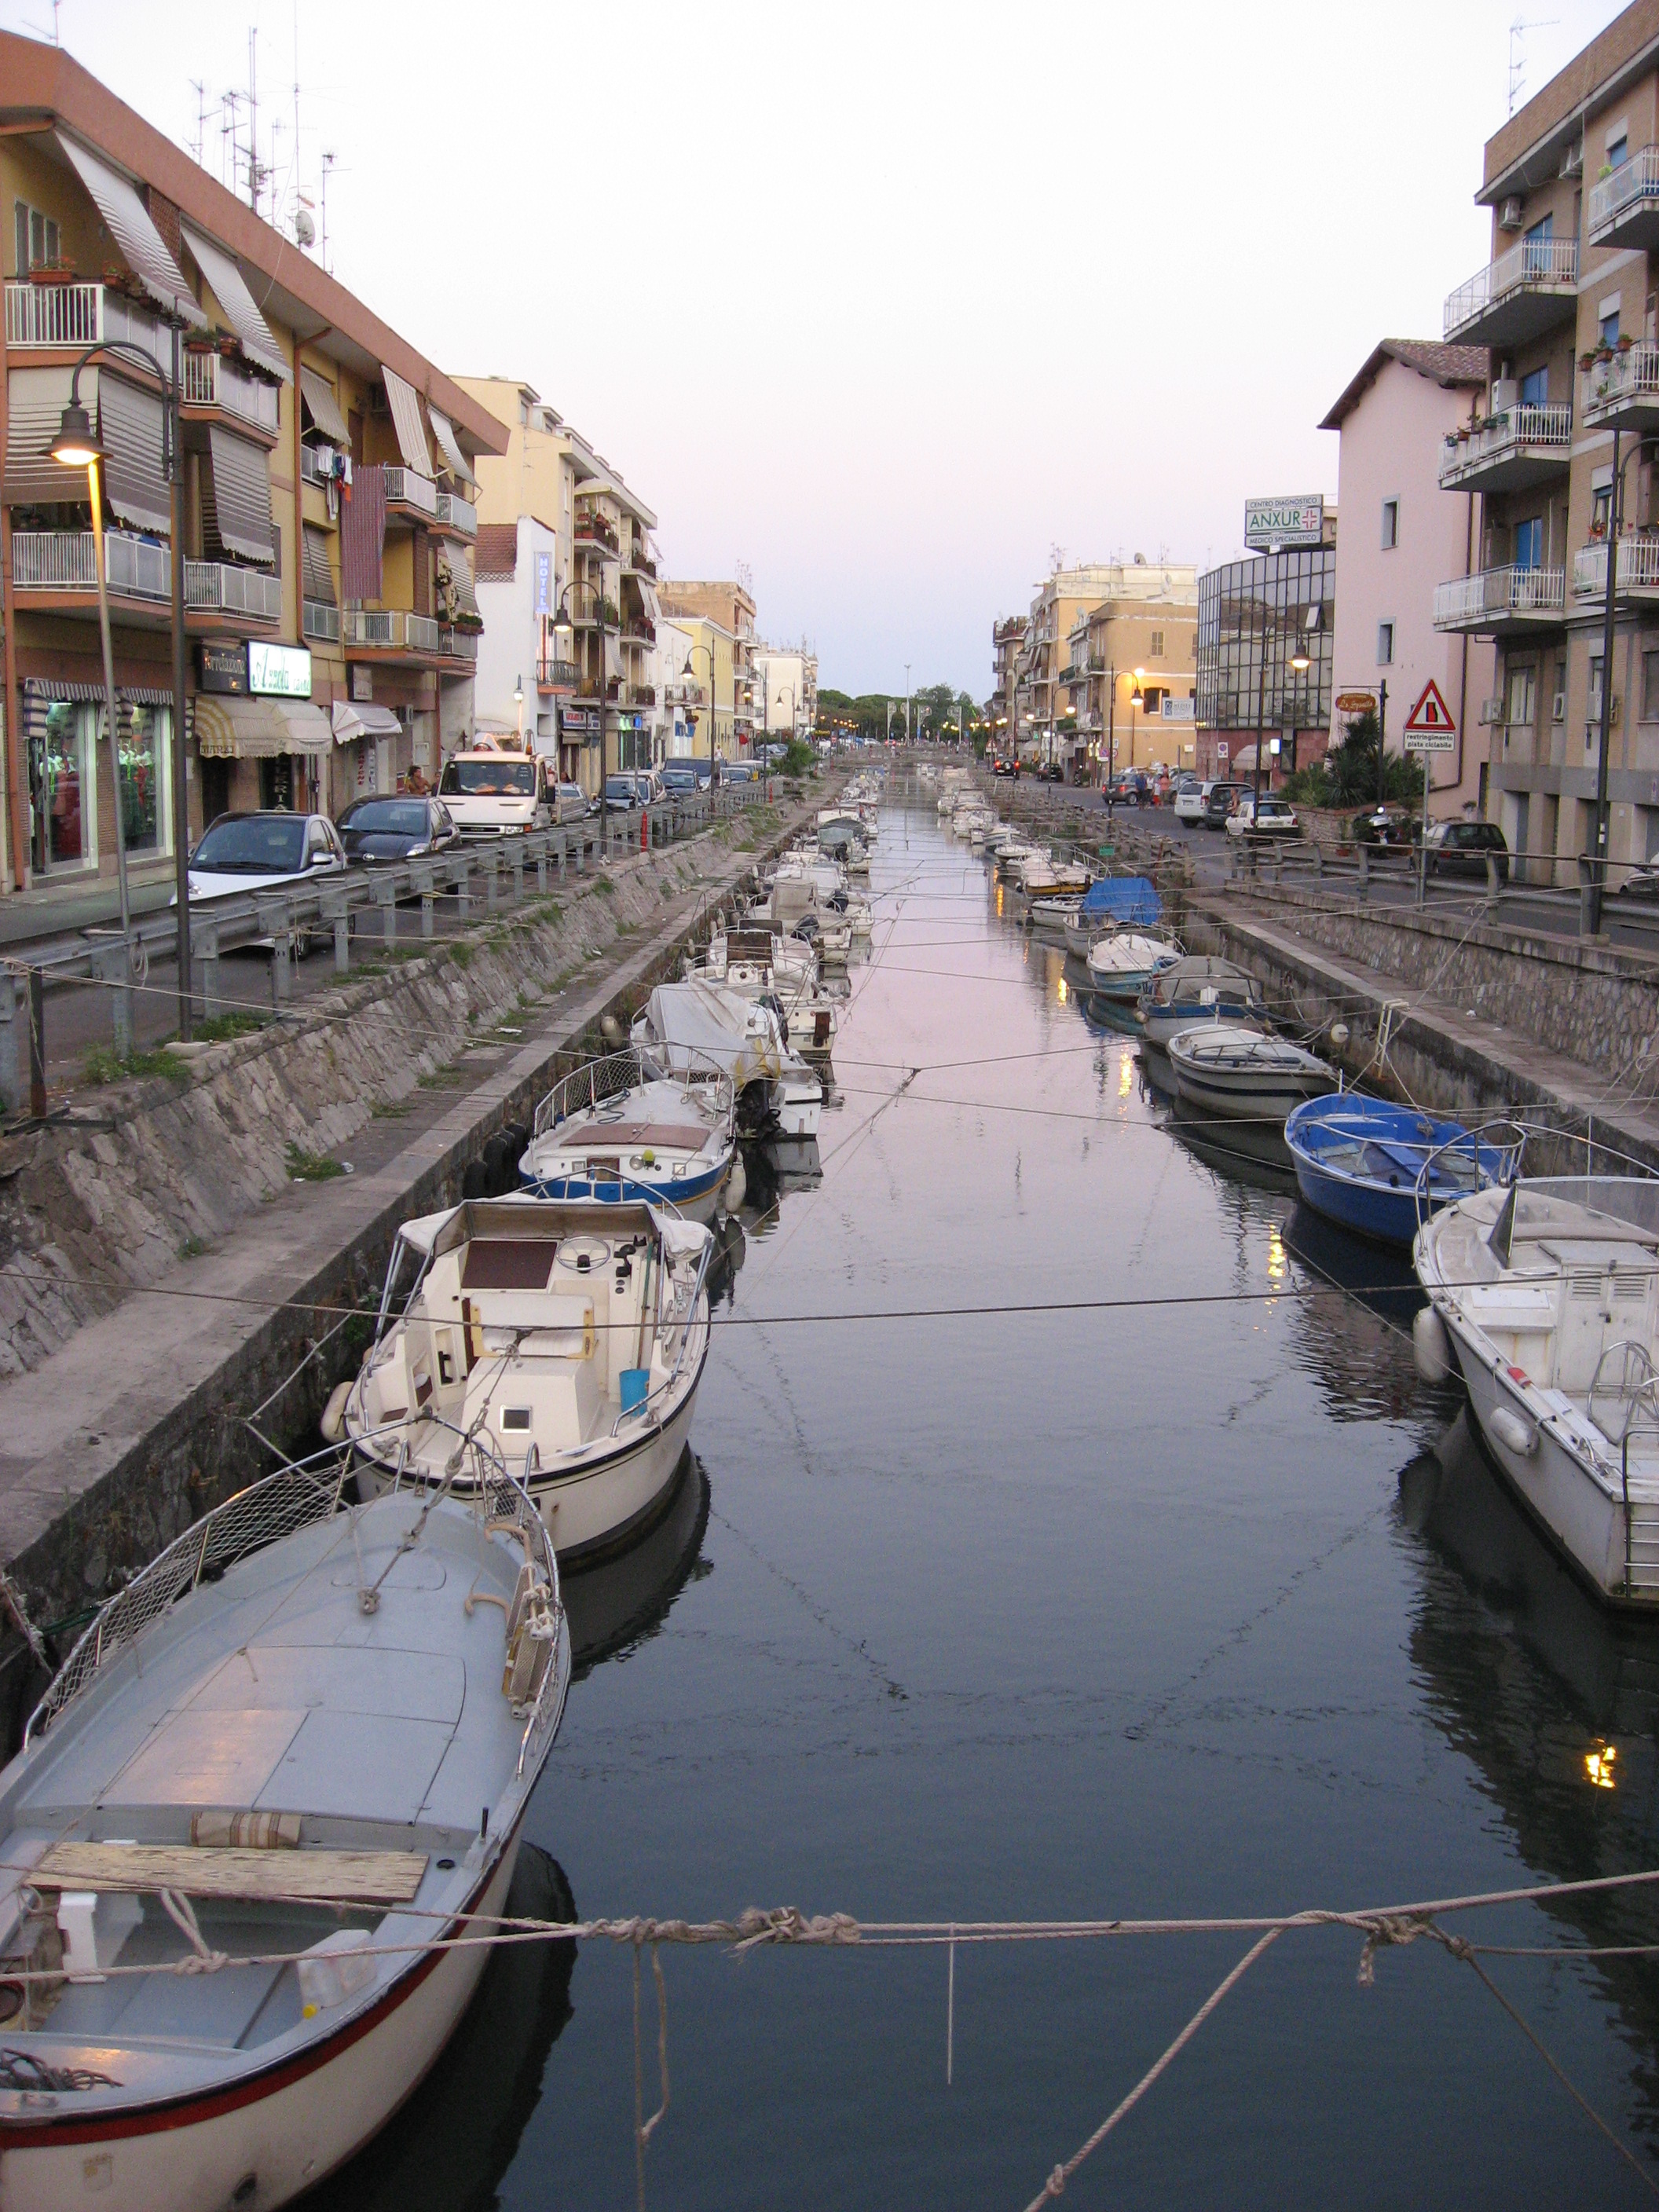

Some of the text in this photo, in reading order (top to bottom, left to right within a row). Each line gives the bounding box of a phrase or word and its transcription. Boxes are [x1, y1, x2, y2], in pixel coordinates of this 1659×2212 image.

[1275, 497, 1317, 506] DIAGNOSTICO
[1250, 511, 1300, 528] ANXUR
[1275, 534, 1317, 543] SPECIALISTICO
[539, 558, 548, 606] HOTEL
